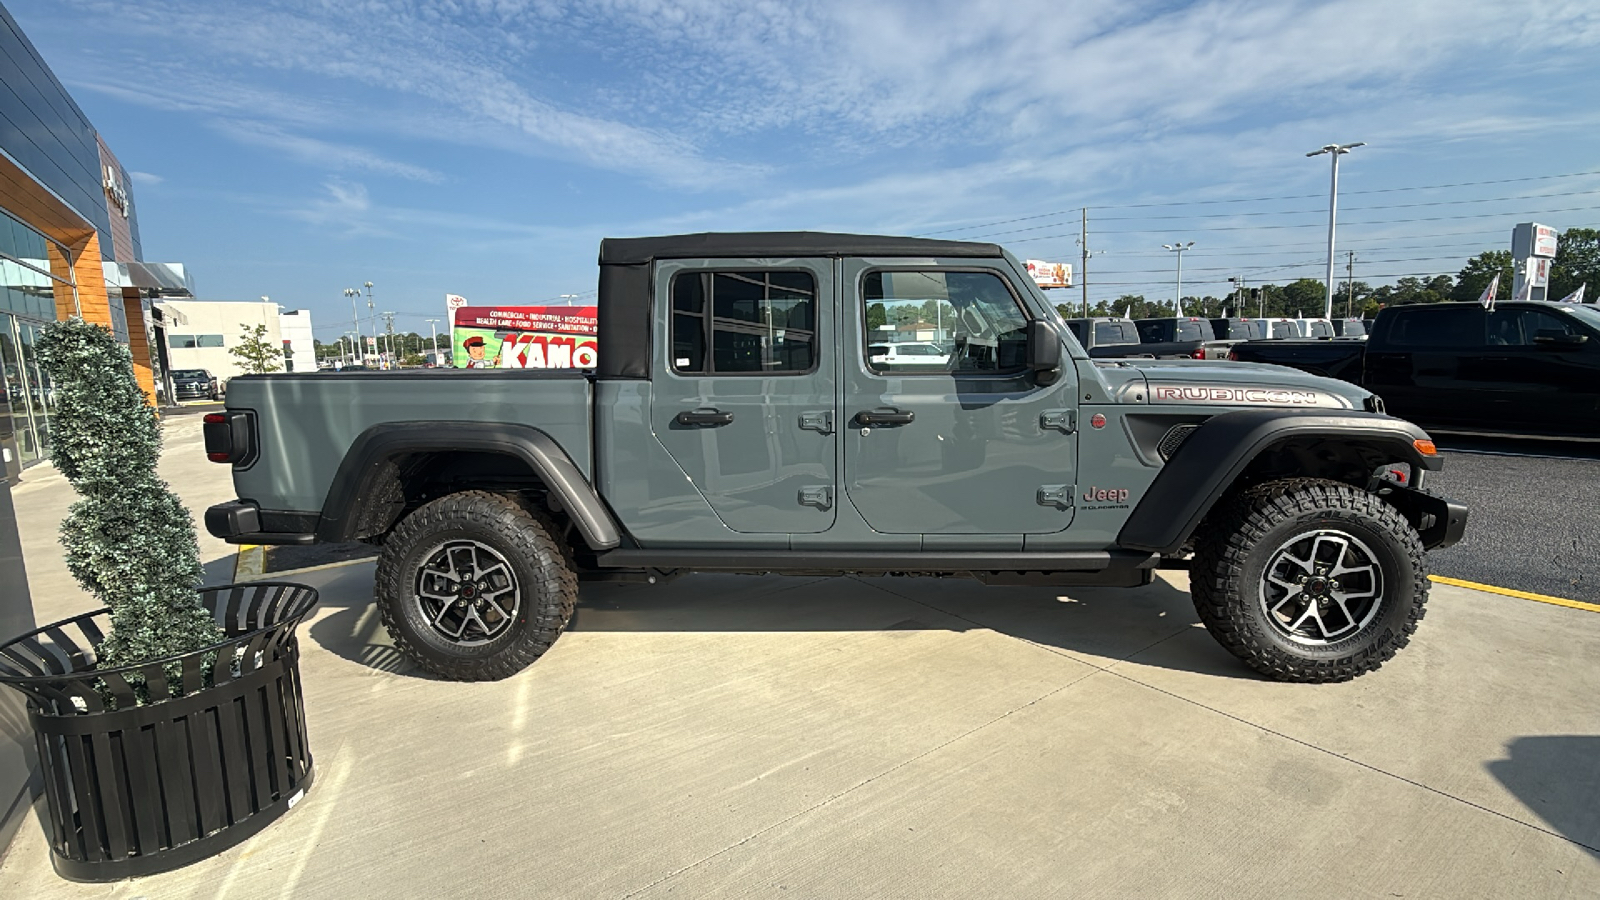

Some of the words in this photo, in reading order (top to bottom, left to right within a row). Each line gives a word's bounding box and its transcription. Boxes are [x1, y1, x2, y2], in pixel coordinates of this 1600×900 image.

[490, 311, 525, 319] COMMERCIAL
[529, 313, 561, 322] INDUSTRIAL
[532, 321, 554, 329] SERVICE
[1156, 387, 1317, 404] RUBICON
[1083, 486, 1129, 503] Jeep
